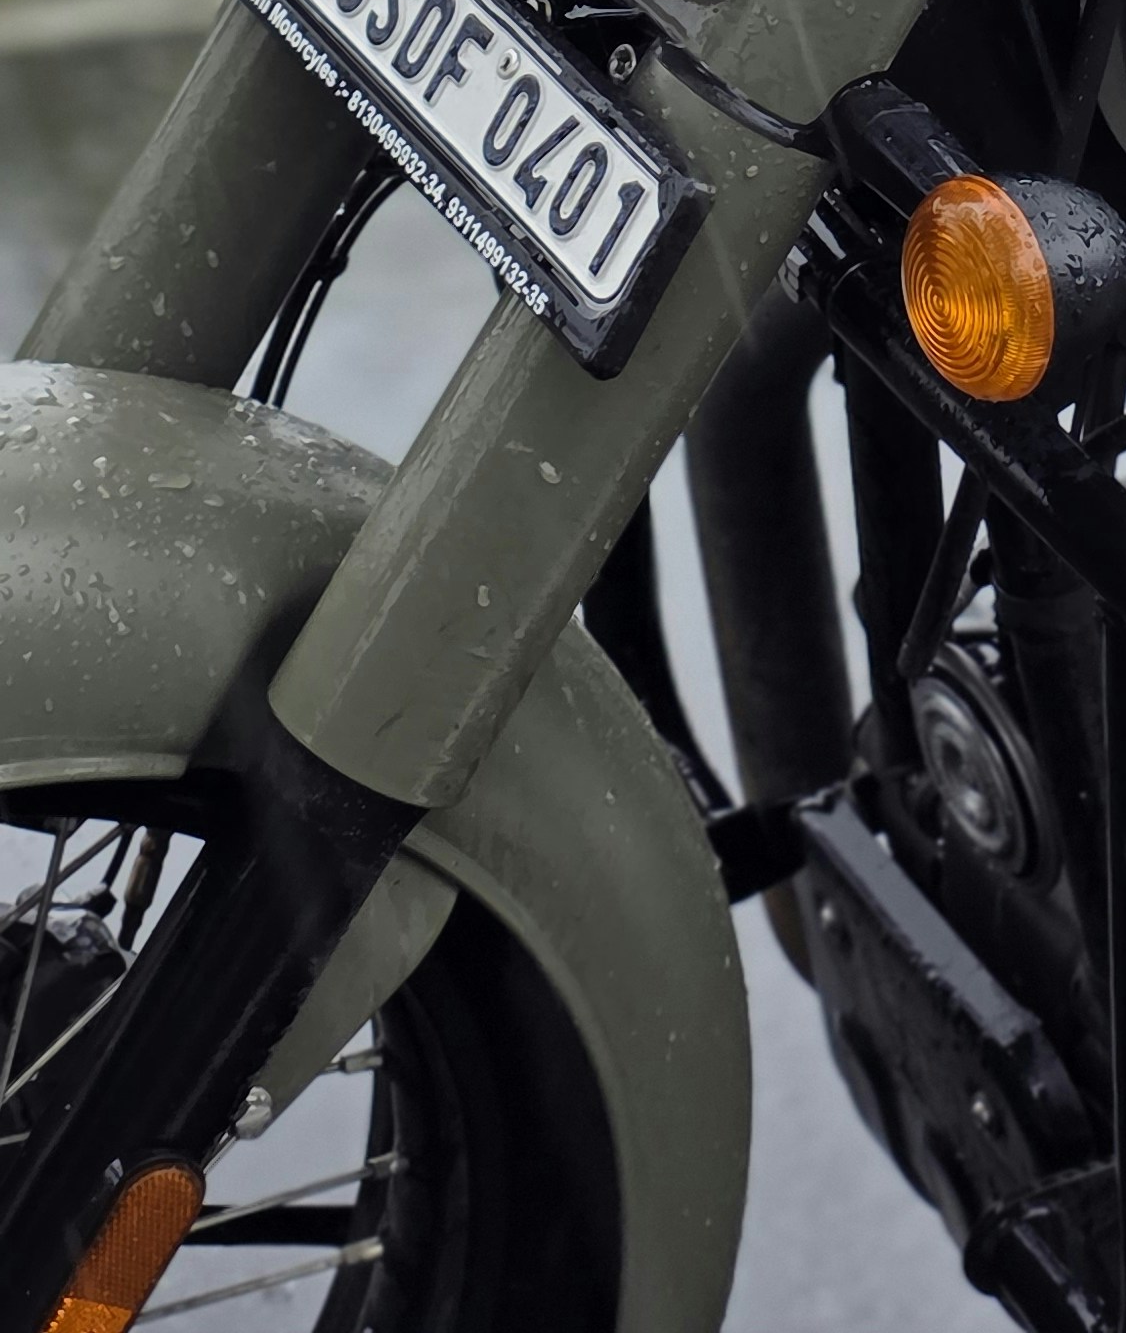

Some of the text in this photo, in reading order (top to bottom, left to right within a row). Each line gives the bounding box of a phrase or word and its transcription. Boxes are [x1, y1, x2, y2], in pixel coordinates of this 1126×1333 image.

[267, 2, 338, 88] Motorcyles
[445, 196, 550, 316] 9311499132-35
[482, 73, 646, 277] 0401
